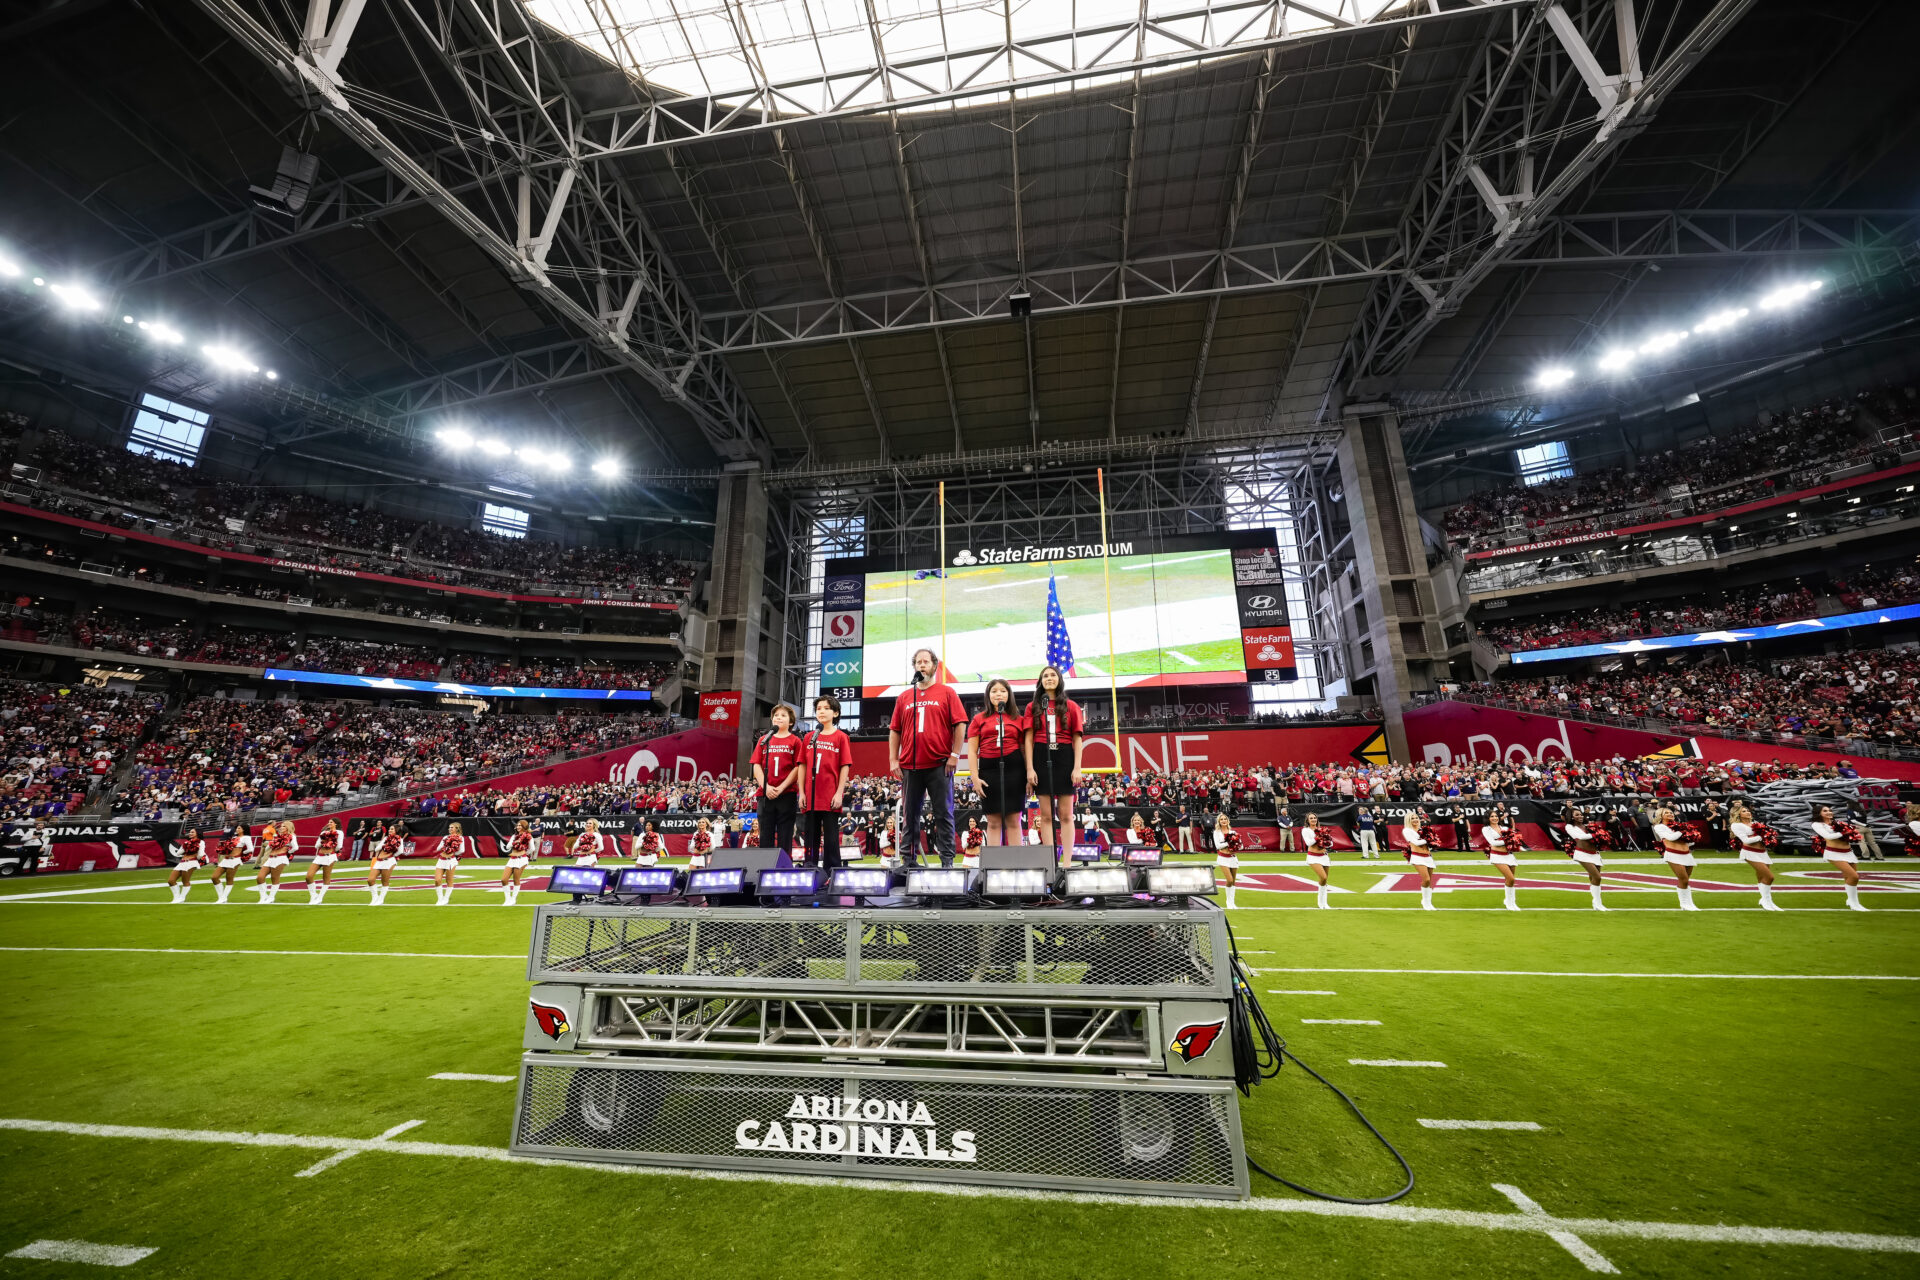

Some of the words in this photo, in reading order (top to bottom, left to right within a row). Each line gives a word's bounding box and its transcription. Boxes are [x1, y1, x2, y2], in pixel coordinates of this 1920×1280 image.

[1492, 546, 1517, 556] JOHN
[1519, 540, 1563, 552] (PADDY)
[1564, 530, 1617, 544] DRISCOLL
[277, 560, 316, 571] ADRIAN
[318, 566, 357, 576] WILSON
[833, 581, 855, 590] Ford
[606, 600, 651, 608] CONZELMAN
[1245, 609, 1282, 617] HYUNDAI
[824, 661, 860, 674] COX
[833, 687, 855, 699] 5:33
[905, 700, 939, 710] ARIZONA
[917, 707, 925, 732] 1
[1047, 714, 1056, 743] 1
[807, 744, 840, 753] CADINALS
[773, 756, 780, 777] 1
[815, 753, 822, 774] 1
[1857, 785, 1900, 796] PRO
[1858, 799, 1902, 810] THE
[785, 1094, 936, 1126] ARIZONA
[735, 1119, 977, 1163] CARDINALS
